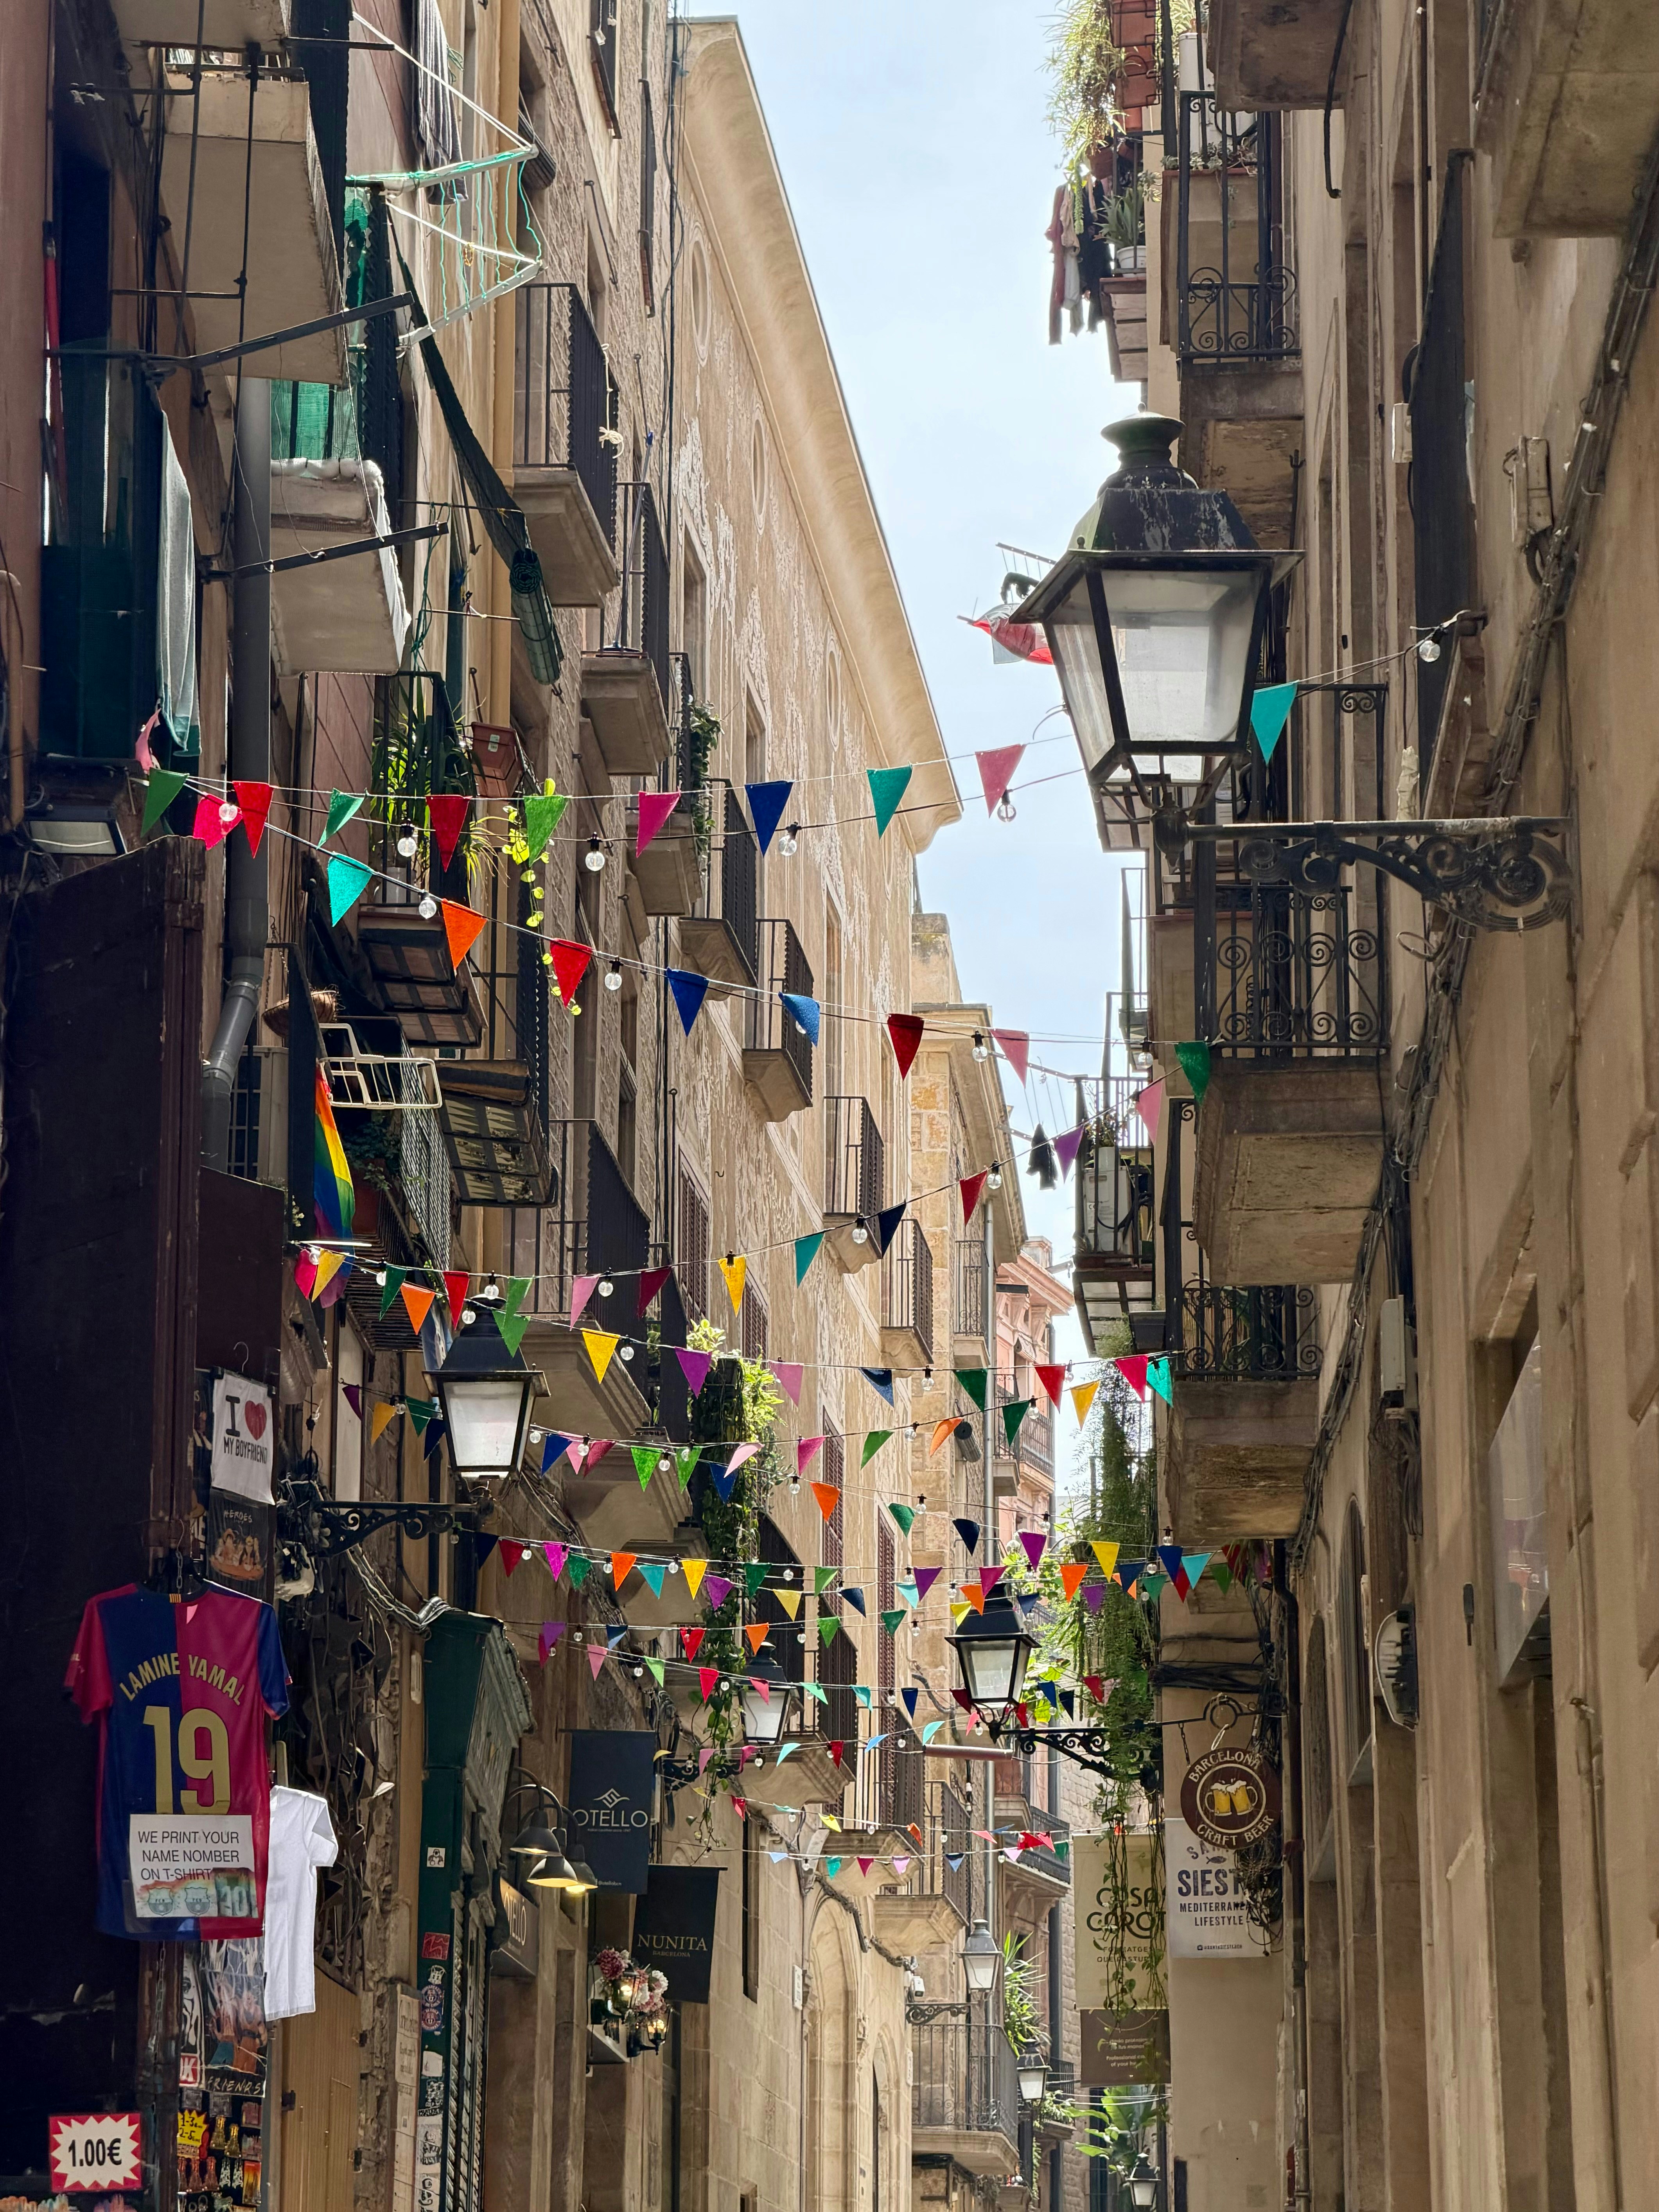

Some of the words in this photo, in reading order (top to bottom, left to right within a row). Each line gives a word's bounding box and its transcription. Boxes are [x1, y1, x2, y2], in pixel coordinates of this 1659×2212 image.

[225, 1395, 240, 1437] I
[224, 1436, 233, 1454] MY
[235, 1440, 268, 1465] BOYFRIEND
[119, 1652, 180, 1701] LAMINE
[188, 1654, 245, 1706] YAMAL
[142, 1705, 231, 1815] 19
[1189, 1750, 1260, 1783] BARCELONA
[573, 1809, 648, 1828] OTELLO
[1197, 1824, 1238, 1846] CRAFT
[1244, 1815, 1274, 1843] BEER
[138, 1831, 158, 1843] WE
[162, 1831, 199, 1844] PRINT
[201, 1831, 239, 1844] YOUR
[142, 1850, 180, 1862] NAME
[183, 1850, 240, 1862] NOMBER
[141, 1868, 160, 1880] ON
[162, 1868, 212, 1880] T-SHIRT
[1177, 1868, 1244, 1897] SIEST
[1194, 1916, 1244, 1927] LIFESTYLE
[637, 1934, 708, 1952] NUNITA
[68, 2138, 122, 2167] 1.00€
